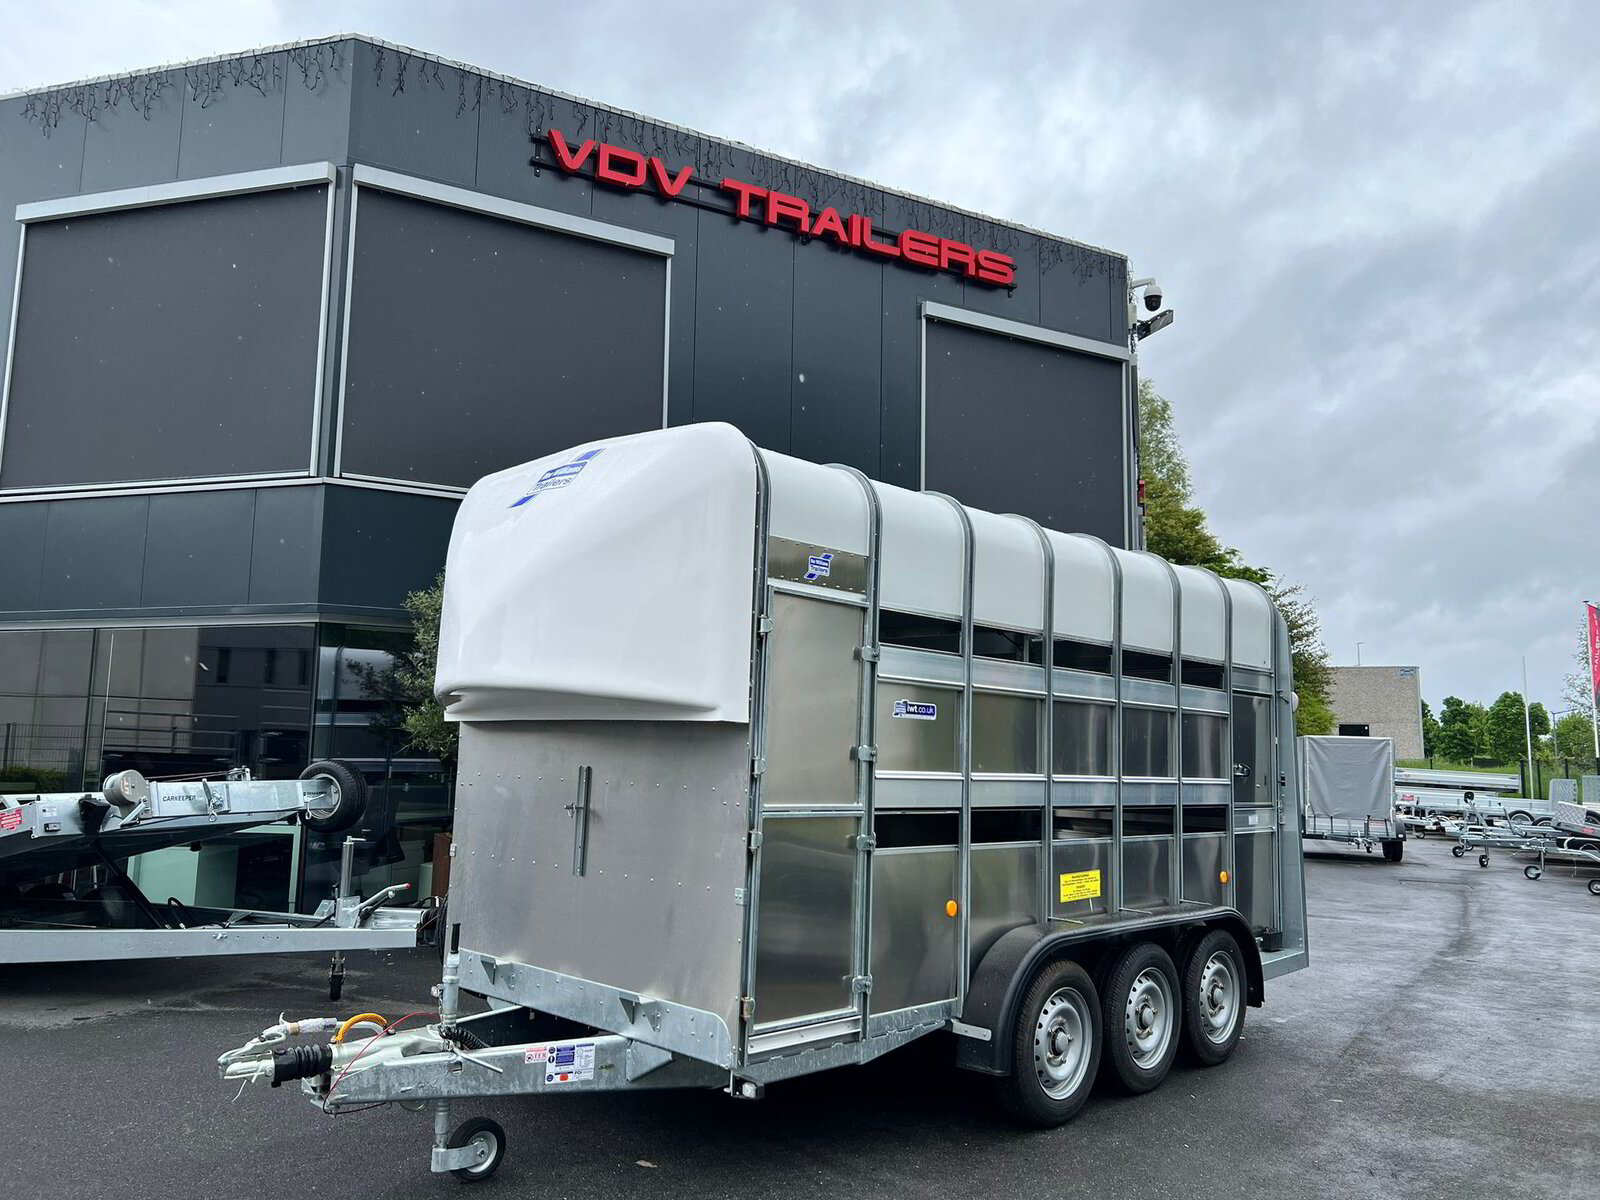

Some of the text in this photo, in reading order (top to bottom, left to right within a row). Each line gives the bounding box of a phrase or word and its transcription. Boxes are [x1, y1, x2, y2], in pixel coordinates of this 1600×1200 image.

[546, 128, 1015, 286] VDV TRAILERS
[532, 476, 572, 492] Trailers
[162, 794, 197, 802] CARKEEPER
